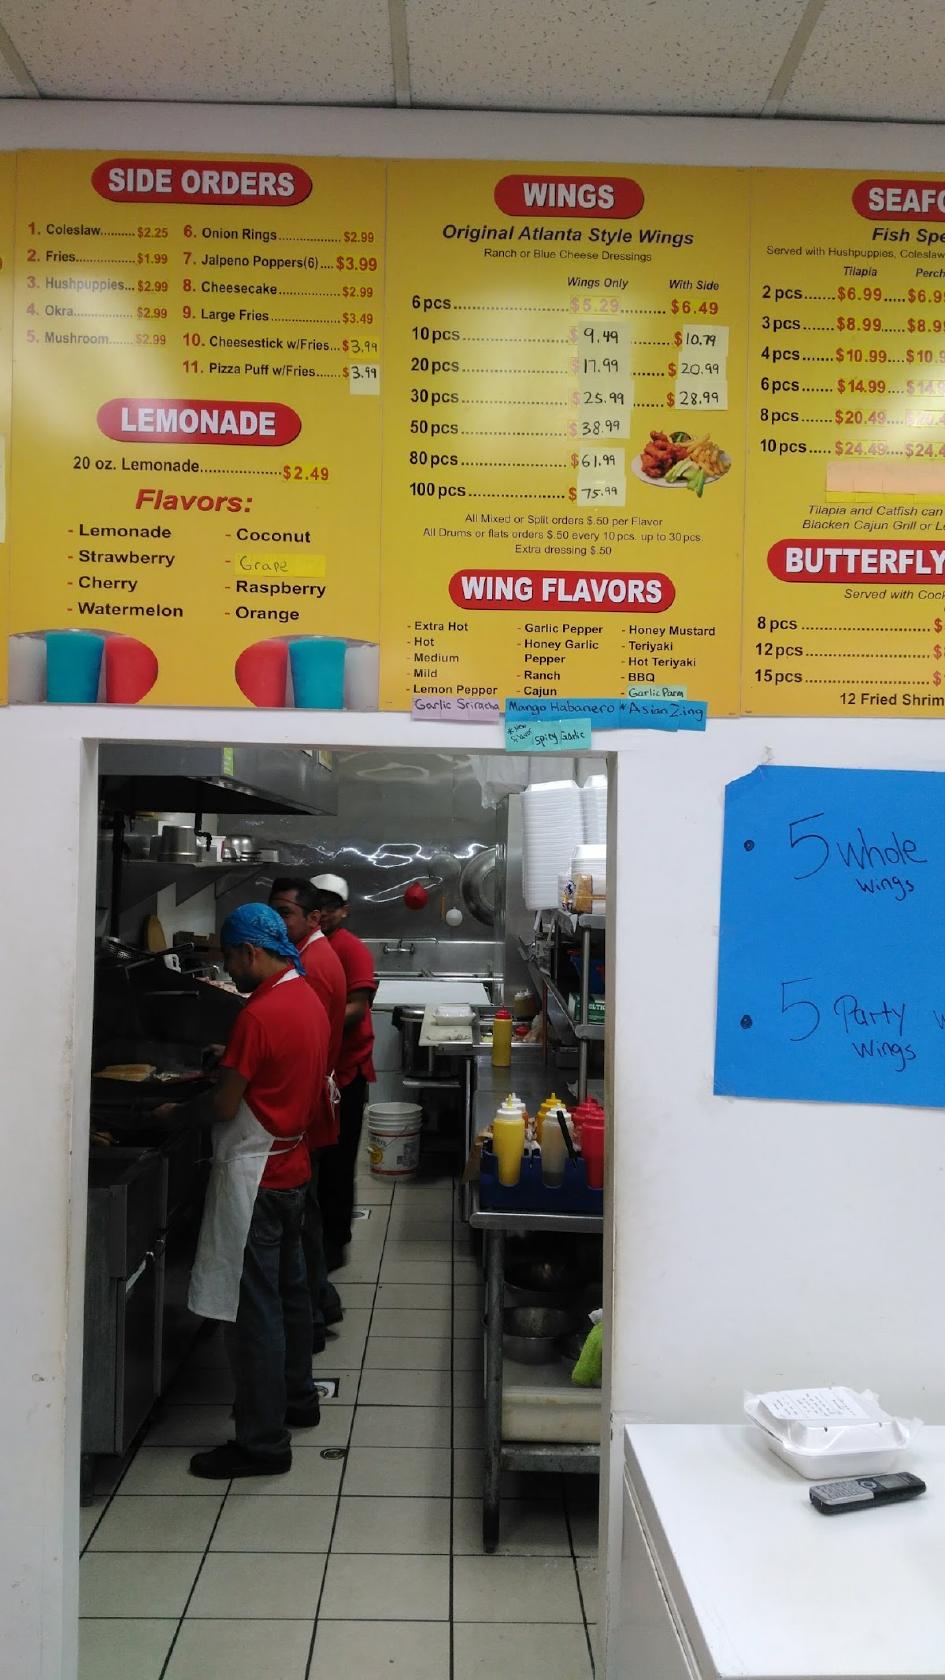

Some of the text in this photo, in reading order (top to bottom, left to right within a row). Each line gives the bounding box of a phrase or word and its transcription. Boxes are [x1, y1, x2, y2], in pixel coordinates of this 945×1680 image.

[108, 168, 296, 197] SIDE ORDERS
[523, 182, 615, 210] WINGS
[46, 224, 100, 236] Coleslaw
[137, 227, 168, 239] $2.25
[202, 228, 238, 240] Onion
[242, 229, 277, 243] Rings
[343, 231, 374, 244] $2.99
[442, 225, 694, 248] Original Atlanta Style Wings
[872, 228, 910, 243] Fish
[46, 251, 76, 262] Fries
[137, 252, 168, 265] $1.99
[484, 248, 652, 263] Ranch or Blue Cheese Dressings
[766, 246, 802, 257] Served
[805, 246, 825, 257] with
[201, 254, 249, 268] Jalpeno
[336, 255, 377, 271] $3.99
[844, 266, 878, 278] Tilapia
[46, 276, 168, 292] Hushpuppies $2.99
[201, 281, 278, 295] Cheesecake
[342, 286, 374, 299] $2.99
[567, 276, 630, 290] Wings Only
[669, 279, 719, 291] With Side
[837, 286, 882, 301] $6.99
[45, 305, 167, 319] Okra $2.99
[570, 297, 719, 314] $5.29 $6.49
[201, 308, 235, 322] Large
[239, 309, 269, 321] Fries
[342, 312, 373, 325] $3.49
[837, 317, 882, 332] $8.99
[45, 332, 166, 346] Mushroom $2.99
[209, 336, 284, 350] Cheesestick
[286, 338, 330, 351] w/Fries
[836, 348, 887, 363] $10.99
[209, 362, 241, 375] Pizza
[245, 363, 269, 375] Puff
[272, 365, 316, 377] w/Fries
[837, 379, 886, 394] $14.99
[121, 407, 276, 437] LEMONADE
[835, 409, 887, 425] $20.49
[835, 440, 887, 456] $24.49
[73, 456, 330, 482] 20 oz. Lemonade $2.49
[135, 488, 253, 513] Flavors:
[808, 505, 943, 517] Tilapia and Catfish can
[465, 514, 478, 524] All
[480, 514, 511, 524] Mixed
[513, 516, 524, 524] or
[527, 515, 549, 526] Split
[551, 516, 584, 525] orders
[612, 518, 629, 528] per
[631, 517, 663, 527] Flavor
[803, 520, 933, 532] Blacken Cajun Grill or
[79, 524, 172, 539] Lemonade
[236, 528, 311, 544] Coconut
[423, 528, 667, 543] All Drums or flats orders every up to
[515, 545, 587, 557] Extra dressing
[79, 550, 175, 568] Strawberry
[240, 555, 289, 573] Grape
[78, 576, 138, 593] Cherry
[236, 580, 326, 598] Raspberry
[461, 576, 662, 604] WING FLAVORS
[844, 589, 913, 600] Served with
[78, 602, 184, 618] Watermelon
[235, 607, 300, 623] Orange
[414, 621, 469, 632] Extra Hot
[524, 623, 604, 637] Garlic Pepper
[629, 625, 716, 638] Honey Mustard
[414, 637, 435, 647] Hot
[524, 639, 600, 651] Honey Garlic
[628, 641, 674, 653] Teriyaki
[414, 652, 460, 663] Medium
[524, 653, 566, 666] Pepper
[628, 657, 697, 669] Hot Teriyaki
[413, 668, 438, 679] Mild
[524, 670, 561, 682] Ranch
[628, 672, 656, 684] BBQ
[413, 684, 498, 697] Lemon Pepper
[524, 686, 557, 698] Cajun
[414, 698, 452, 711] Garlic
[840, 693, 897, 706] 12 Fried
[509, 701, 615, 715] Mango Habanero
[789, 812, 830, 880] 5
[782, 977, 821, 1042] 5
[833, 994, 906, 1037] Party
